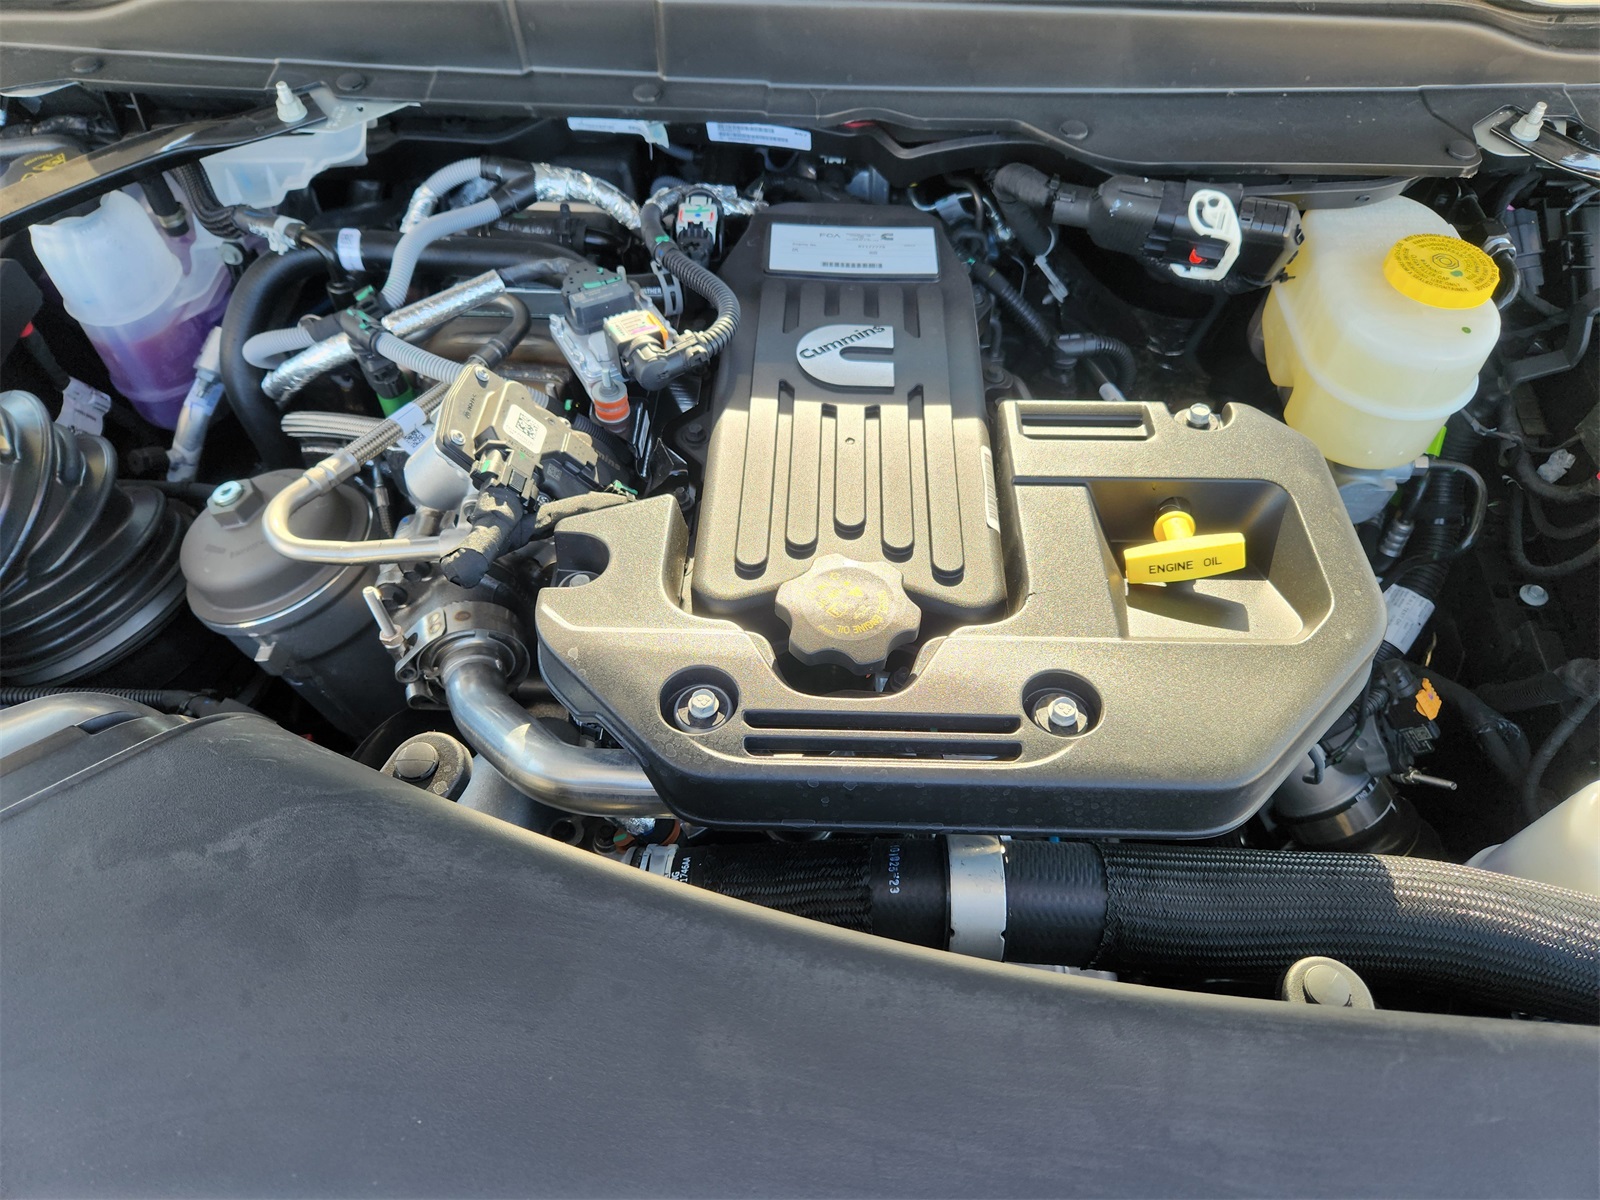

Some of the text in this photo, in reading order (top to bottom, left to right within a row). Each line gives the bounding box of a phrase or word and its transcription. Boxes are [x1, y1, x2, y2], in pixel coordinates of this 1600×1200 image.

[799, 325, 885, 359] Cummins
[1148, 556, 1223, 575] ENGINE OIL
[837, 624, 851, 634] OIL
